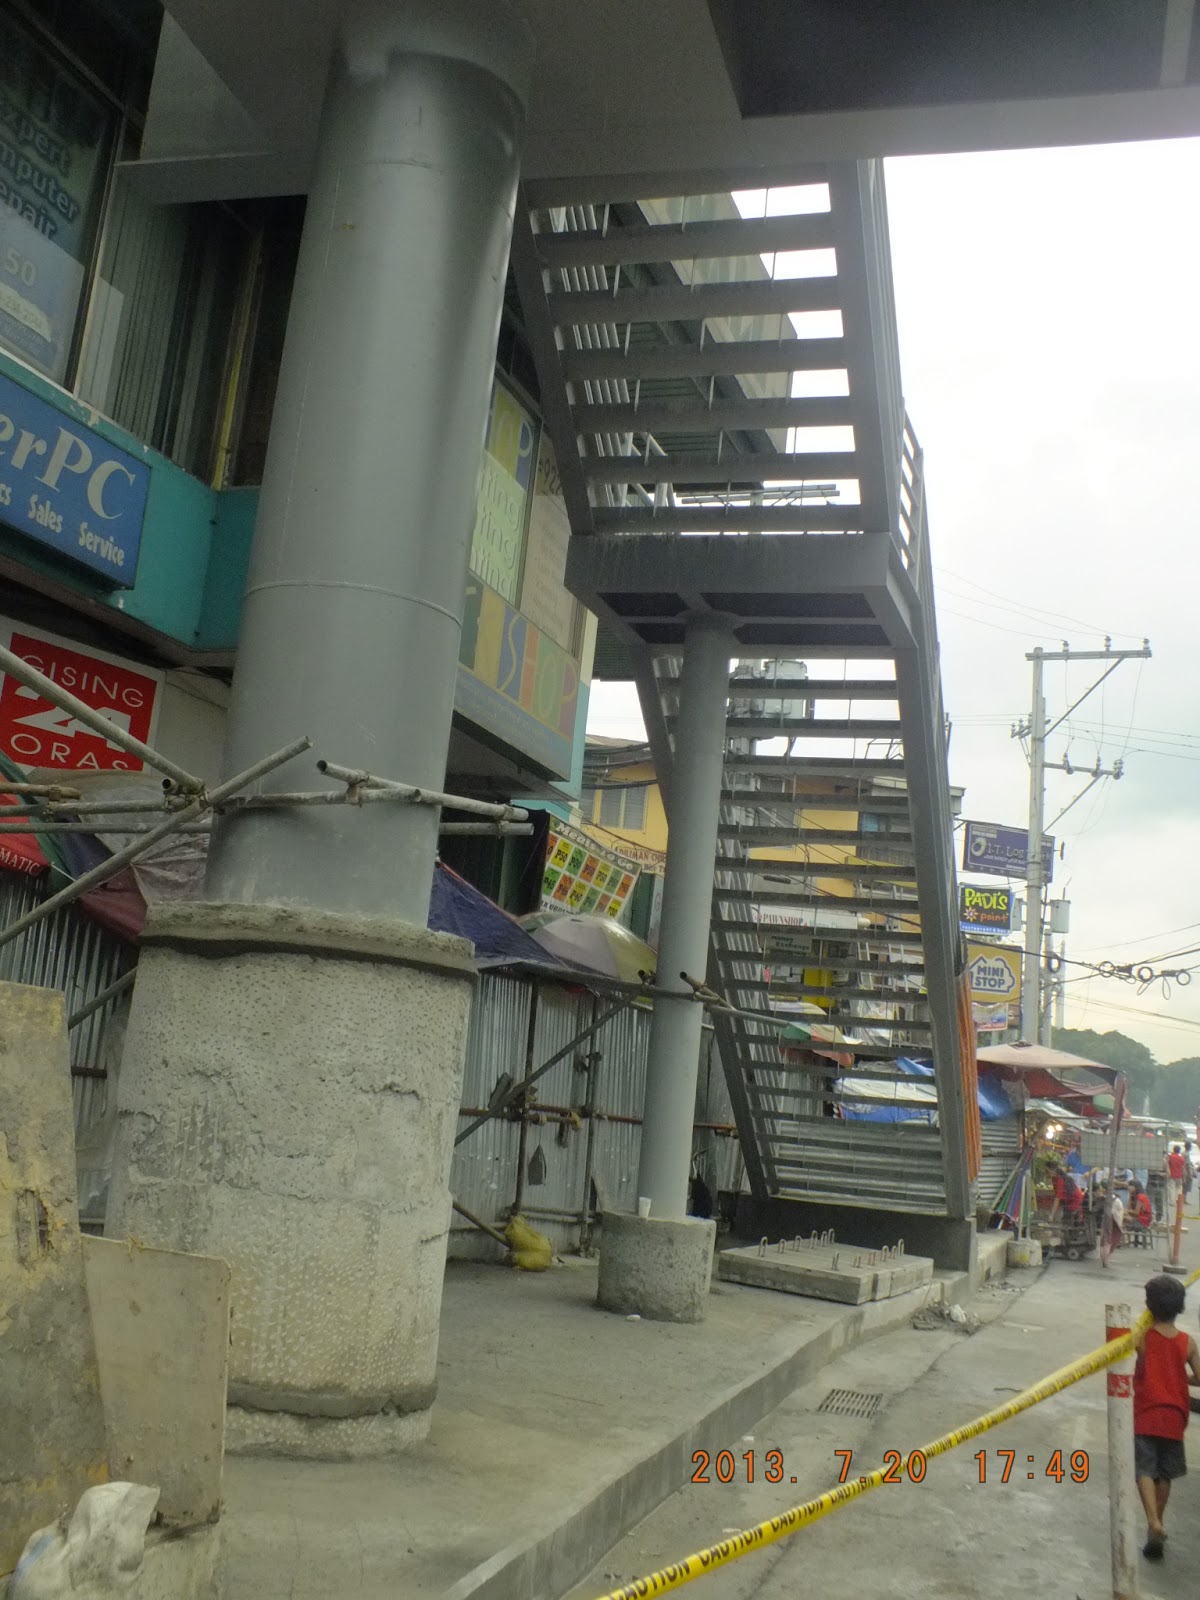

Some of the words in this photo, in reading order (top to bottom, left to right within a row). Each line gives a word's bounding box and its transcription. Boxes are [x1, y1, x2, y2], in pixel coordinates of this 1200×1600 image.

[28, 494, 64, 533] Sales
[78, 521, 125, 567] Service
[21, 655, 144, 708] GISING
[980, 912, 1008, 922] point
[975, 976, 1005, 988] STOP
[977, 966, 1004, 977] MINI
[699, 1526, 763, 1567] CAUTION
[771, 1499, 824, 1532] CAUTION
[830, 1476, 875, 1504] CAUTION
[920, 1437, 952, 1458] AUTION
